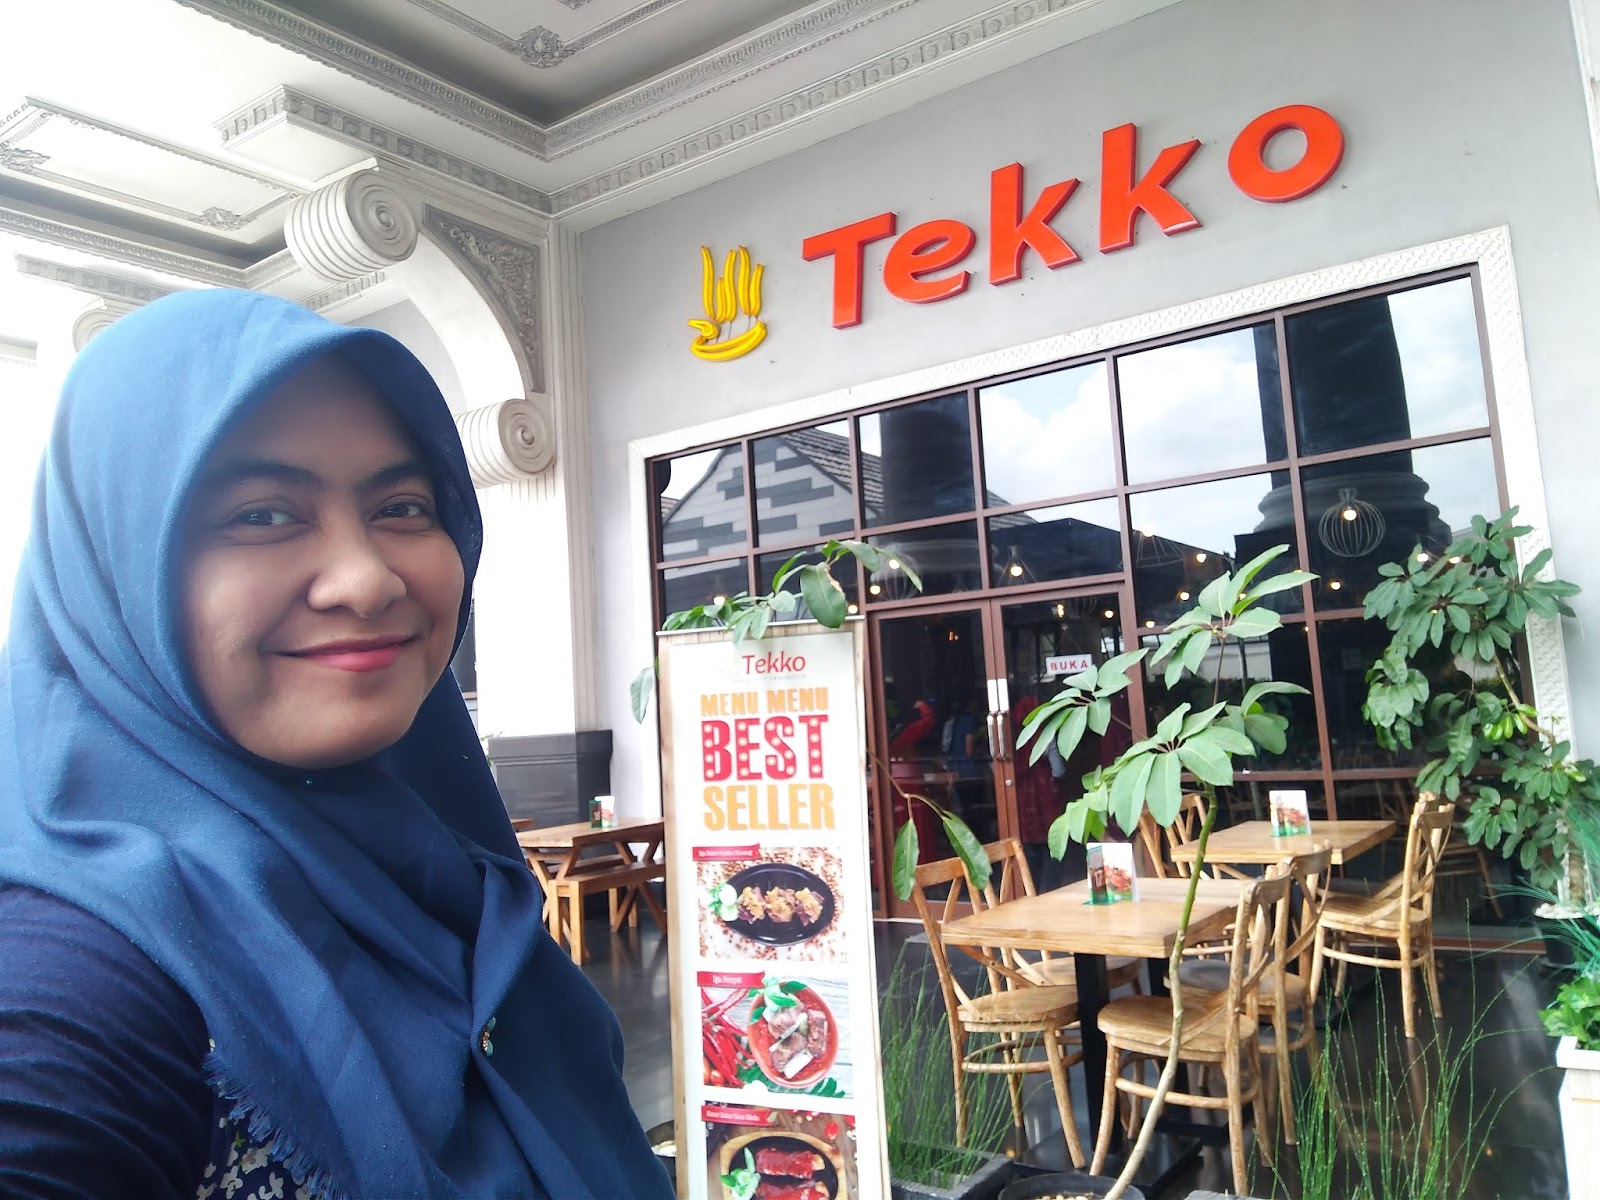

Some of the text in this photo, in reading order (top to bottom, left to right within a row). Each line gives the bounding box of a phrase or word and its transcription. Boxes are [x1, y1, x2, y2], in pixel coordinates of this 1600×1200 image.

[803, 104, 1346, 329] Tekko
[742, 651, 806, 674] Tekko
[1050, 660, 1088, 671] BUKA
[701, 687, 829, 716] MENU MENU
[701, 714, 829, 782] BEST
[703, 783, 836, 831] SELLER
